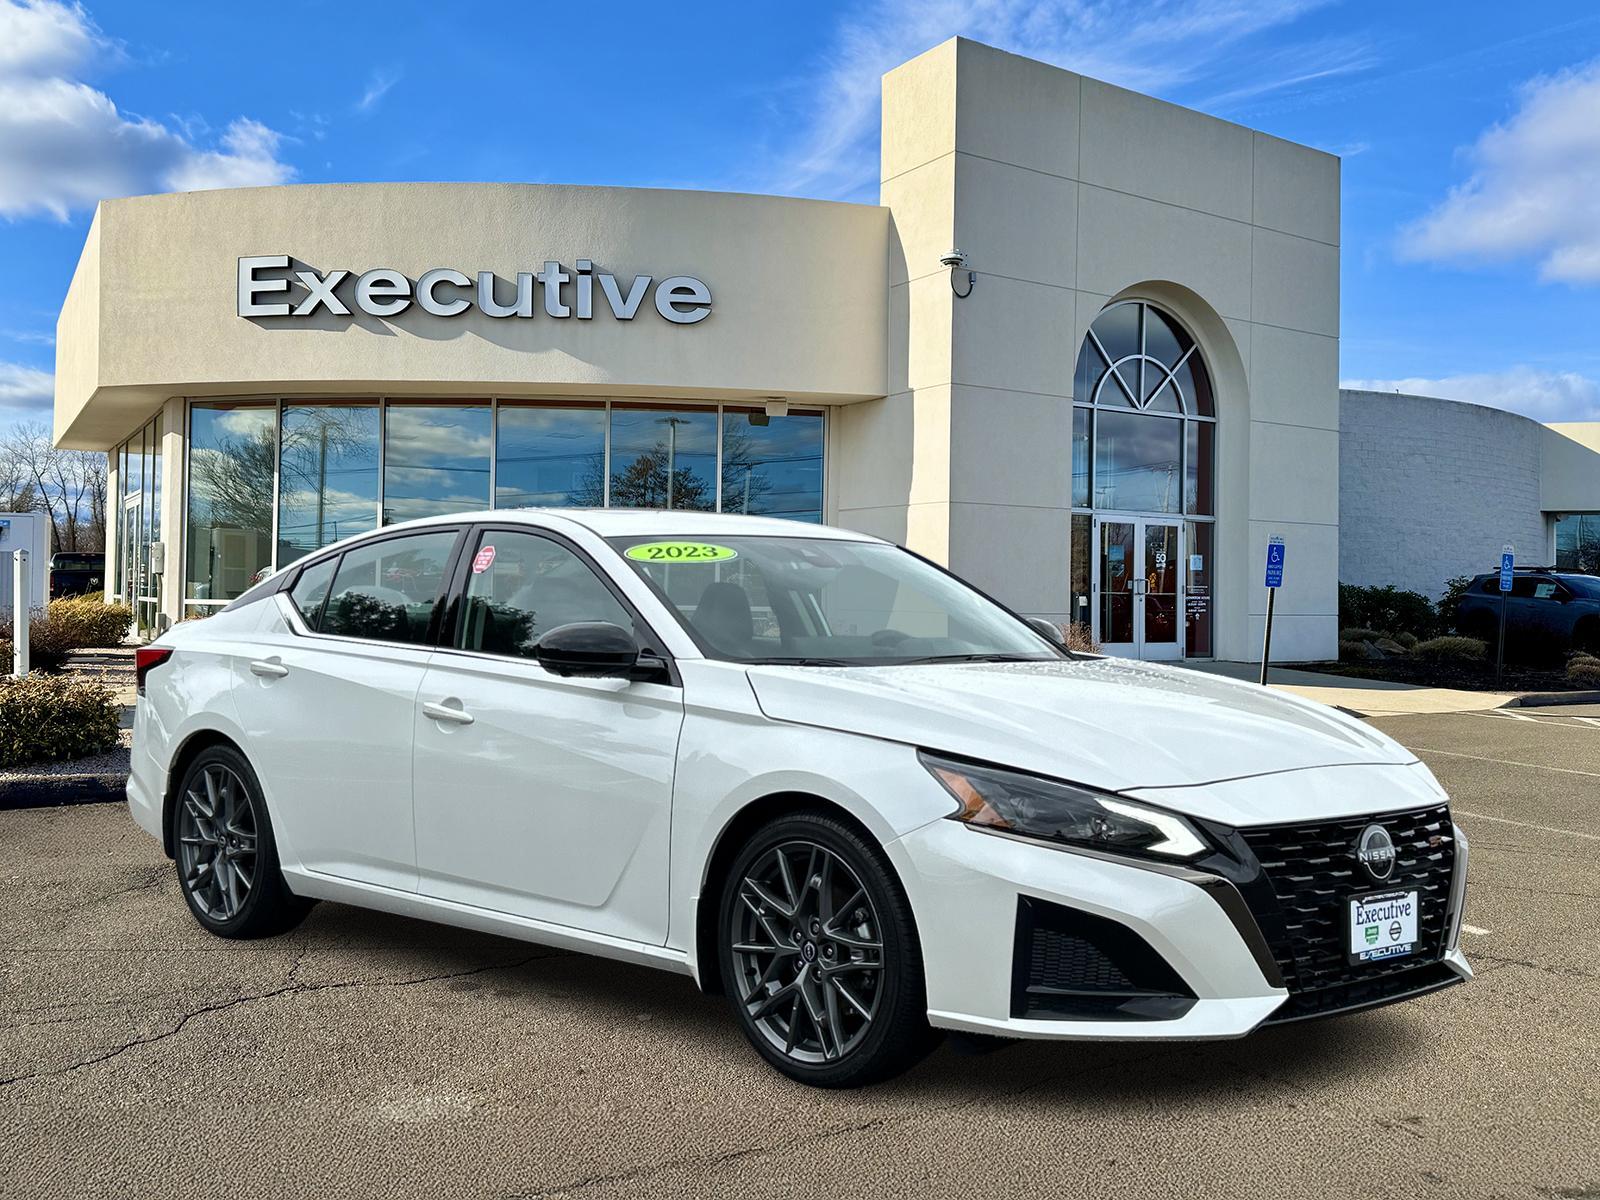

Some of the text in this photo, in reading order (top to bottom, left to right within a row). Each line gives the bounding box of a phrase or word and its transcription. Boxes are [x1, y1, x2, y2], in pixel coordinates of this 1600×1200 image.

[237, 254, 713, 325] Executive
[647, 545, 718, 560] 2023
[1356, 900, 1412, 925] Executive
[1359, 943, 1412, 961] EXECUTIVE
